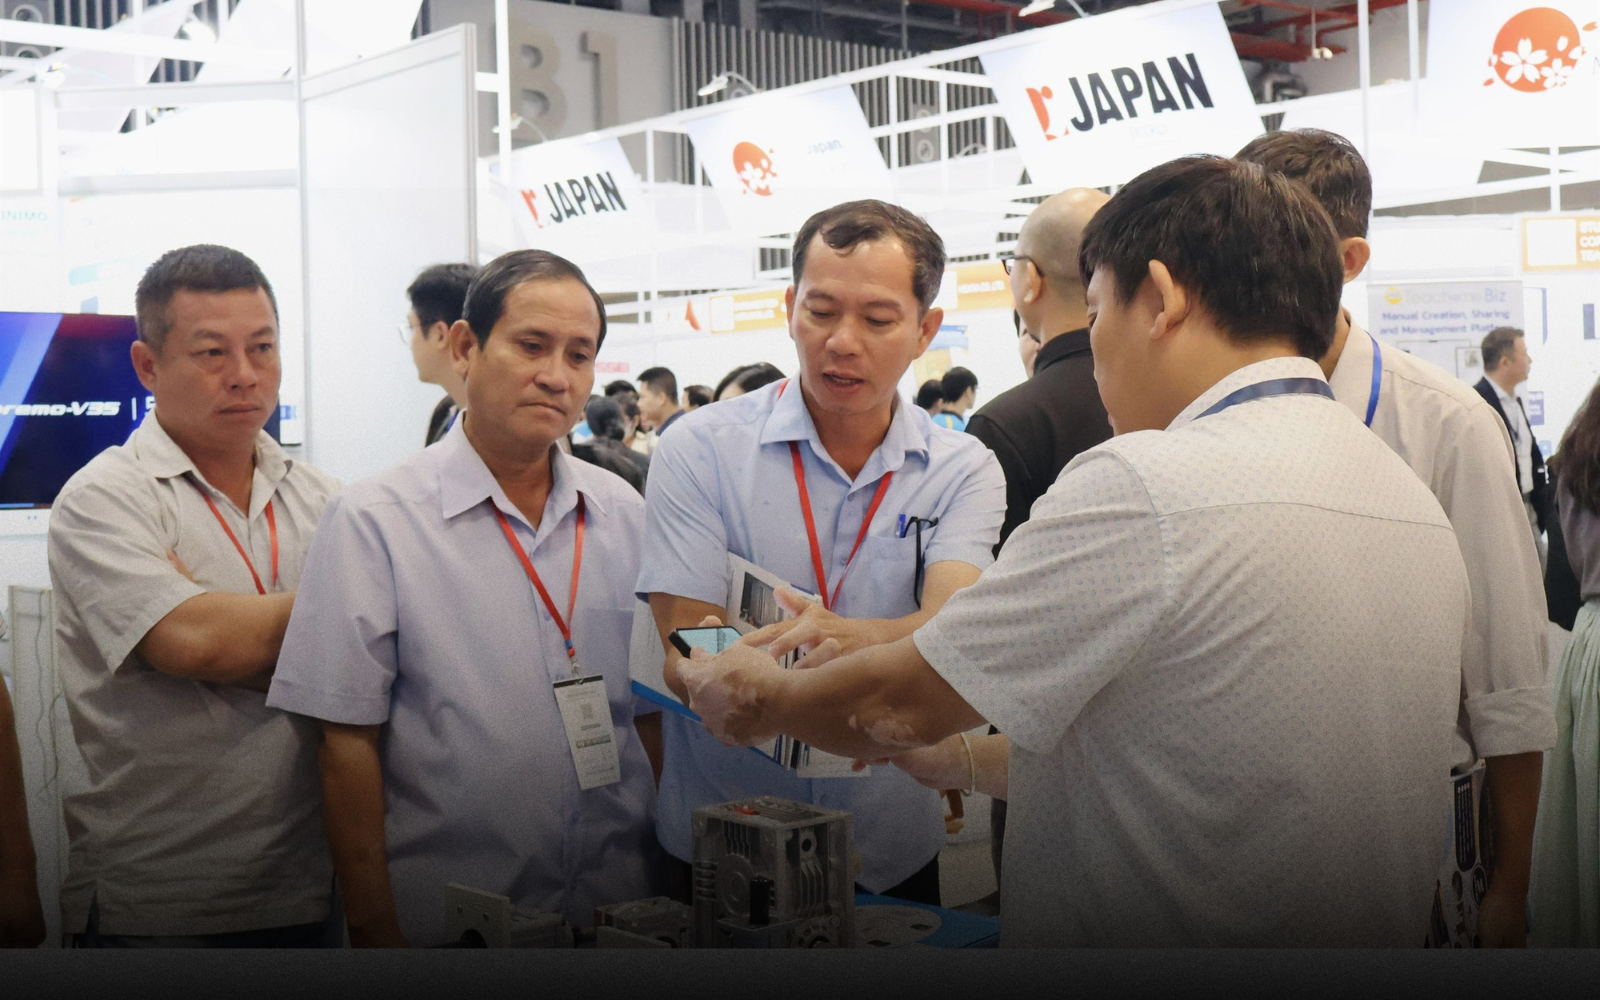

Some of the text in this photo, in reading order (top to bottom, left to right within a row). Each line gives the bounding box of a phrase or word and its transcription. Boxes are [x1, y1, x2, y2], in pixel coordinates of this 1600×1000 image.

[1068, 52, 1215, 132] JAPAN
[543, 171, 628, 223] JAPAN
[1484, 287, 1507, 303] Biz
[1382, 309, 1510, 321] Manual Creation, Sharing
[1380, 326, 1398, 335] and
[1401, 324, 1467, 336] Management
[0, 401, 121, 416] remo-V35
